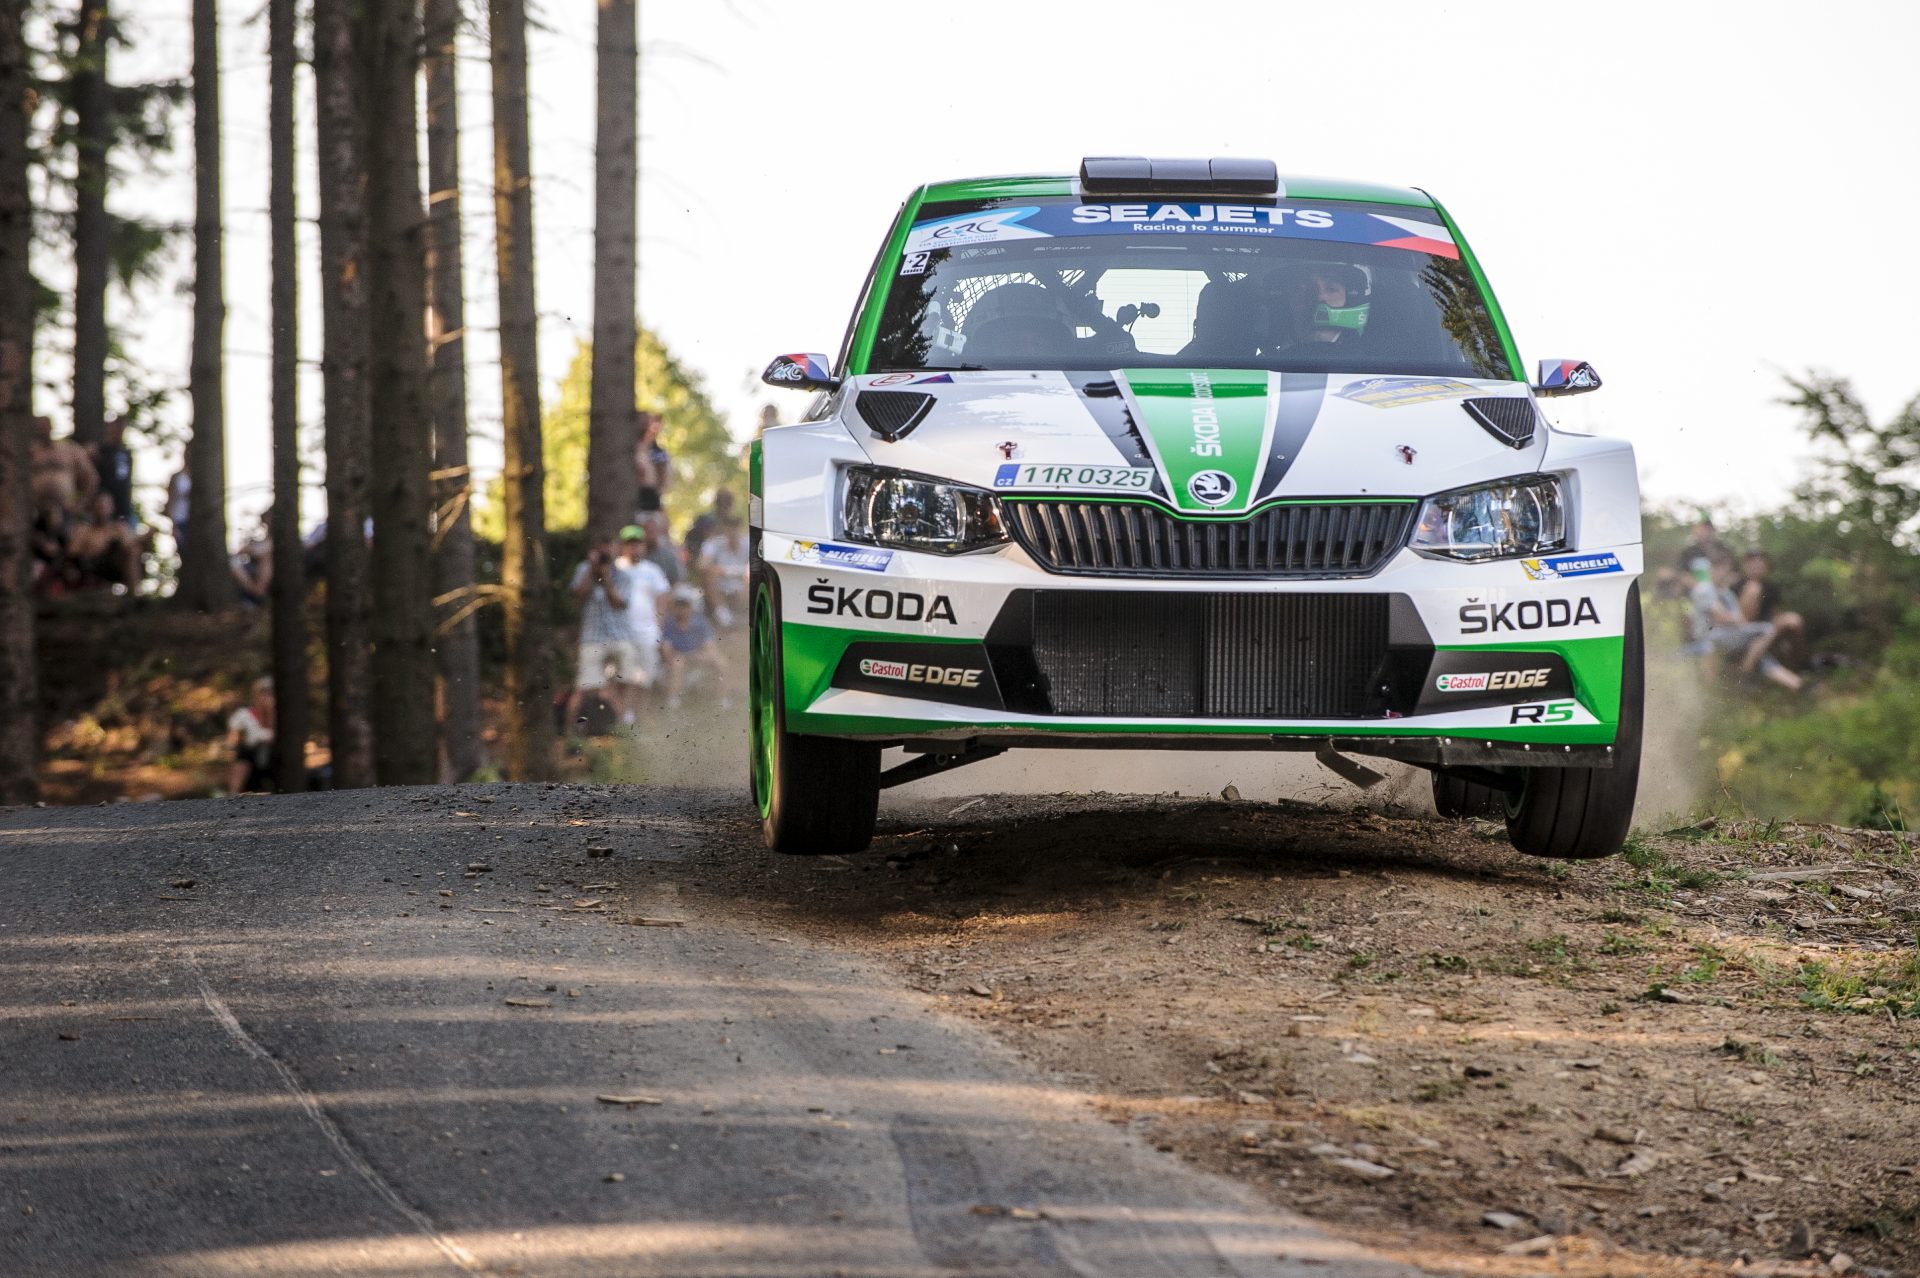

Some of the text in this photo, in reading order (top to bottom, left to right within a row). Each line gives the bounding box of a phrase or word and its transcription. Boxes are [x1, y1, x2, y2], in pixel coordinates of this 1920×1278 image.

[1071, 204, 1334, 229] SEAJETS
[1133, 223, 1275, 234] Racing to summer
[1190, 407, 1222, 456] ŠKODA
[997, 478, 1012, 486] CZ
[1024, 466, 1149, 487] 11R 0325
[825, 551, 890, 564] MICHELIN
[1556, 557, 1618, 572] MICHELIN
[807, 578, 958, 625] ŠKODA
[1459, 596, 1601, 635] ŠKODA
[872, 662, 984, 688] Castrol EDGE
[1449, 668, 1552, 690] Castrol EDGE
[1509, 702, 1575, 725] R5
